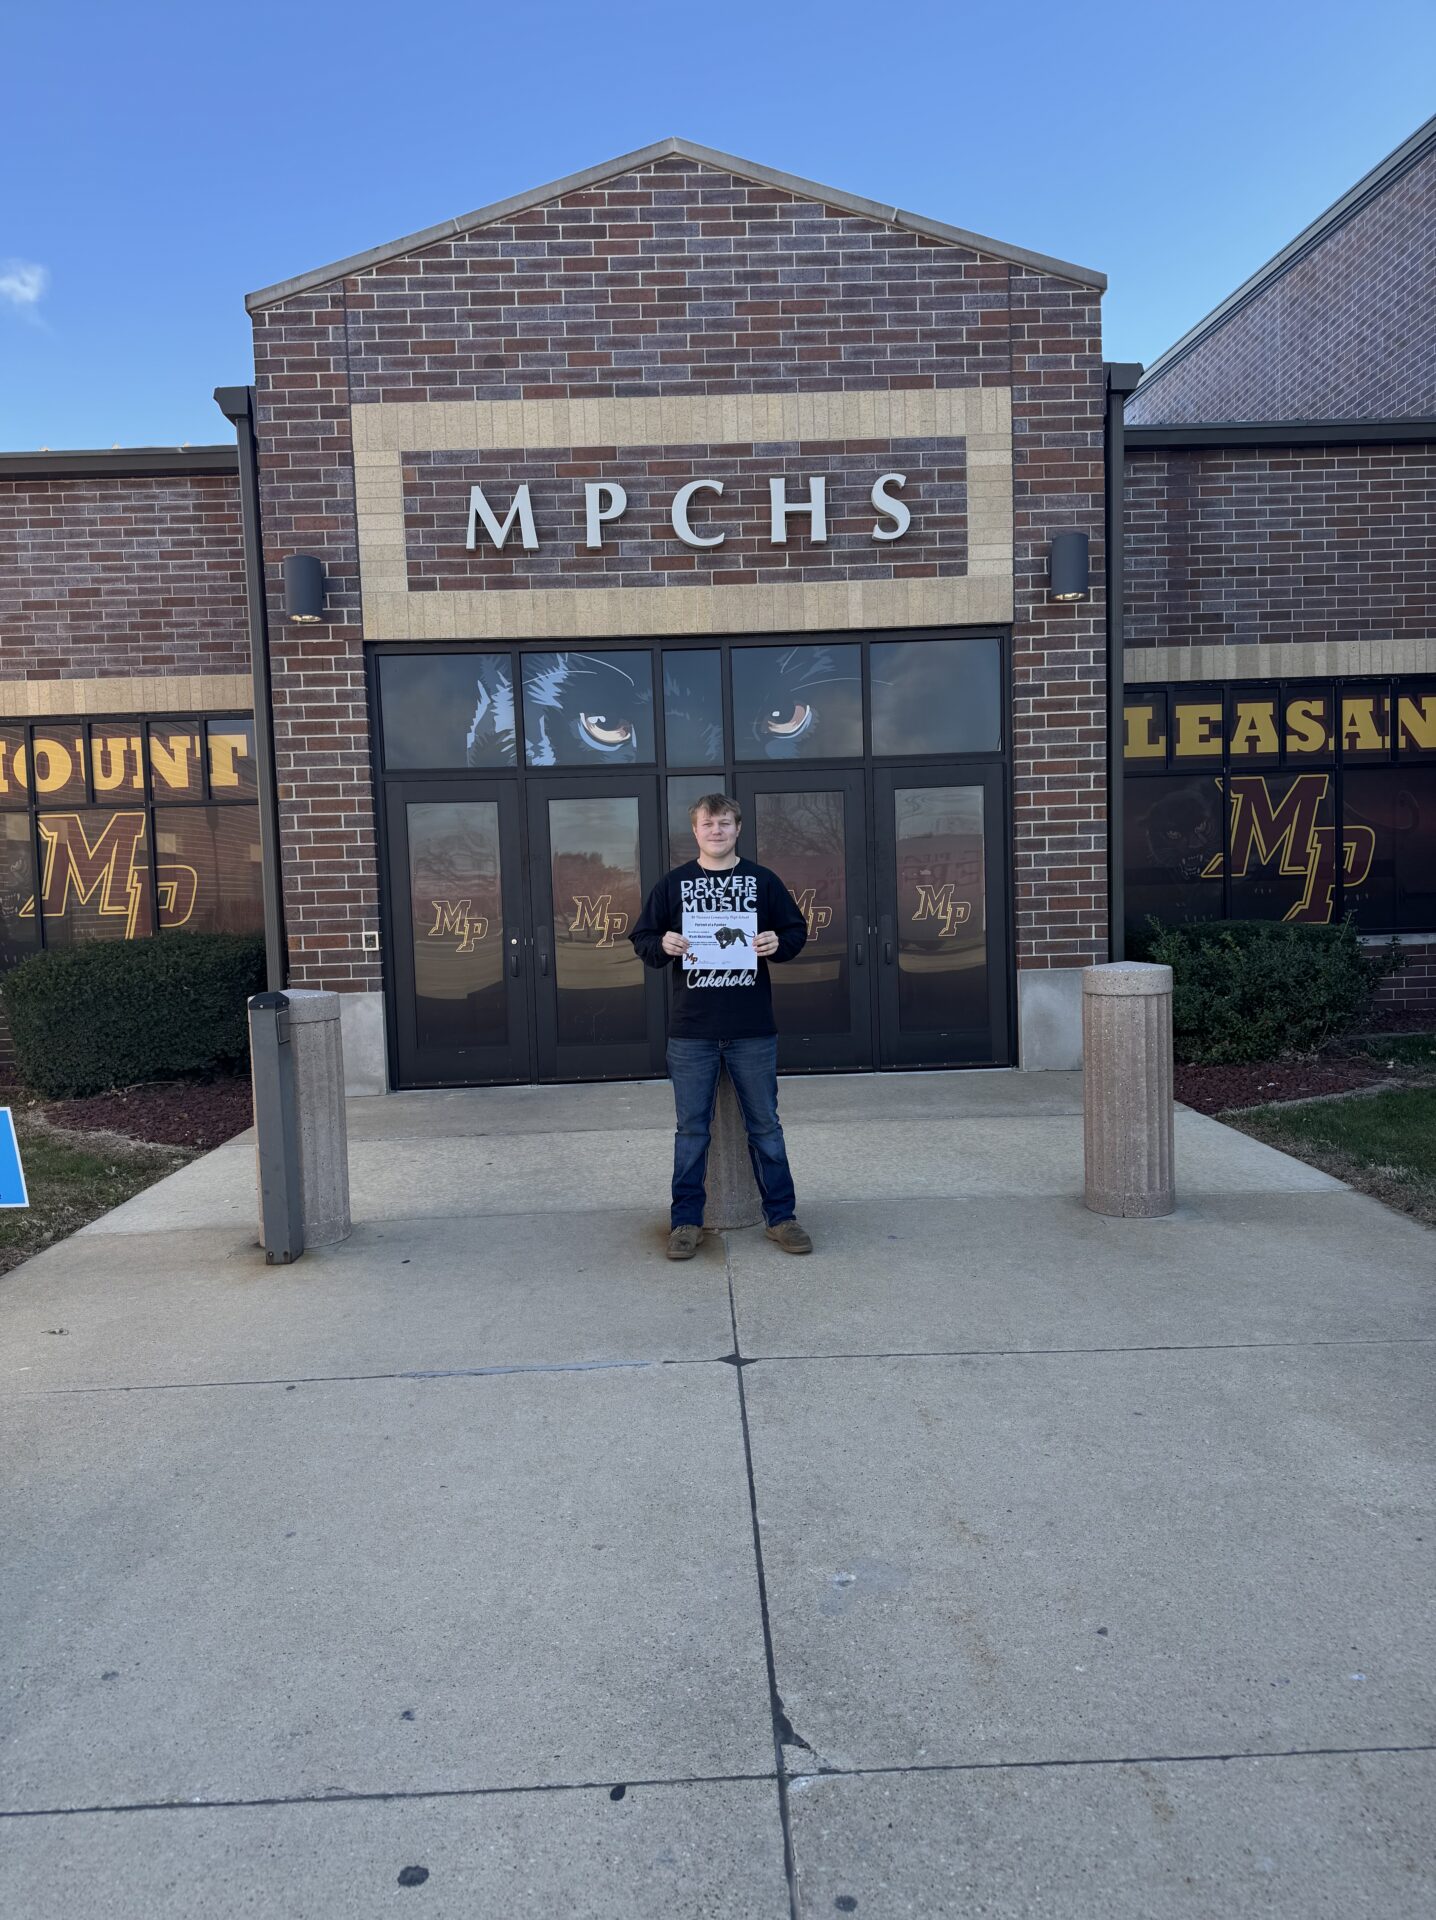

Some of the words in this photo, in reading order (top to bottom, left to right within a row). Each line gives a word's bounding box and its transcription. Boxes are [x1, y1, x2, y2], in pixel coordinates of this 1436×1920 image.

[0, 733, 249, 794] OUNT
[680, 875, 757, 891] DRIVER
[682, 888, 724, 901] PICKS
[728, 886, 758, 898] THE
[682, 897, 757, 912] MUSIC
[686, 969, 757, 989] Cakehole!
